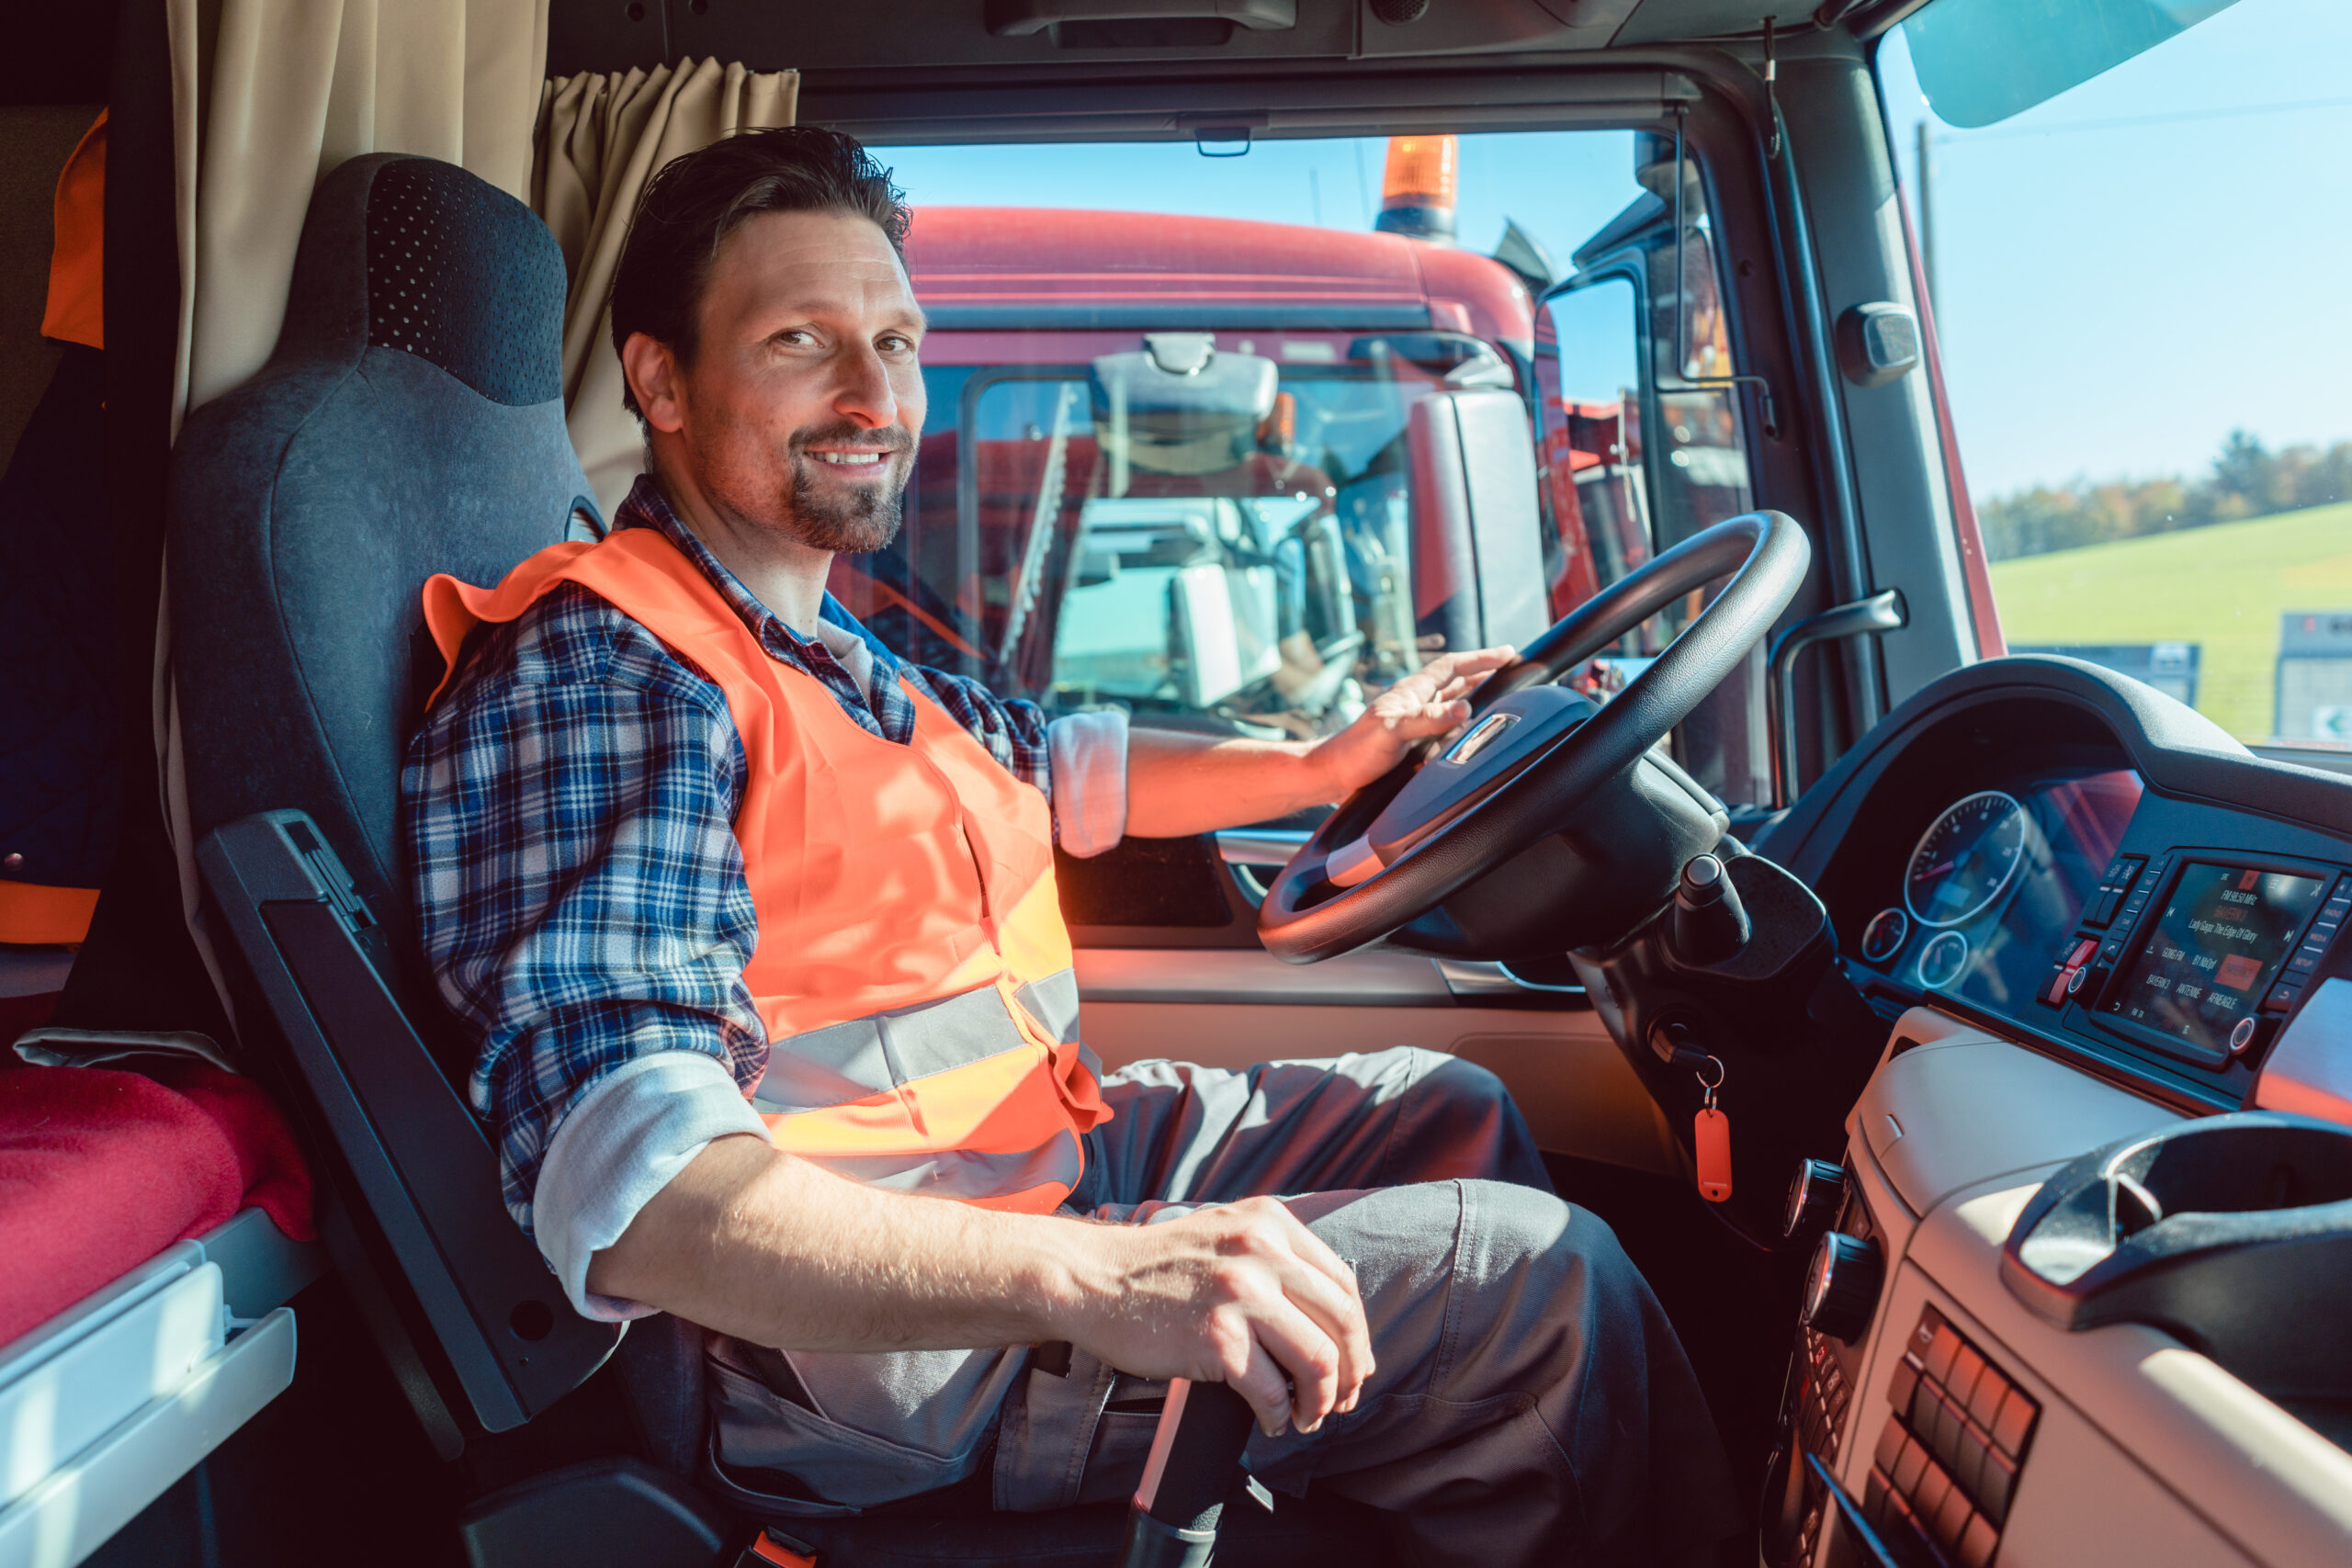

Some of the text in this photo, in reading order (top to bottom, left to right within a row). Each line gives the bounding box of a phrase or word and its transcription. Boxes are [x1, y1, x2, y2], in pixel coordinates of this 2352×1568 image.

[2187, 919, 2202, 931] Lady
[2212, 923, 2226, 935] The
[2222, 925, 2238, 939] Edge
[2240, 929, 2259, 944] Glory
